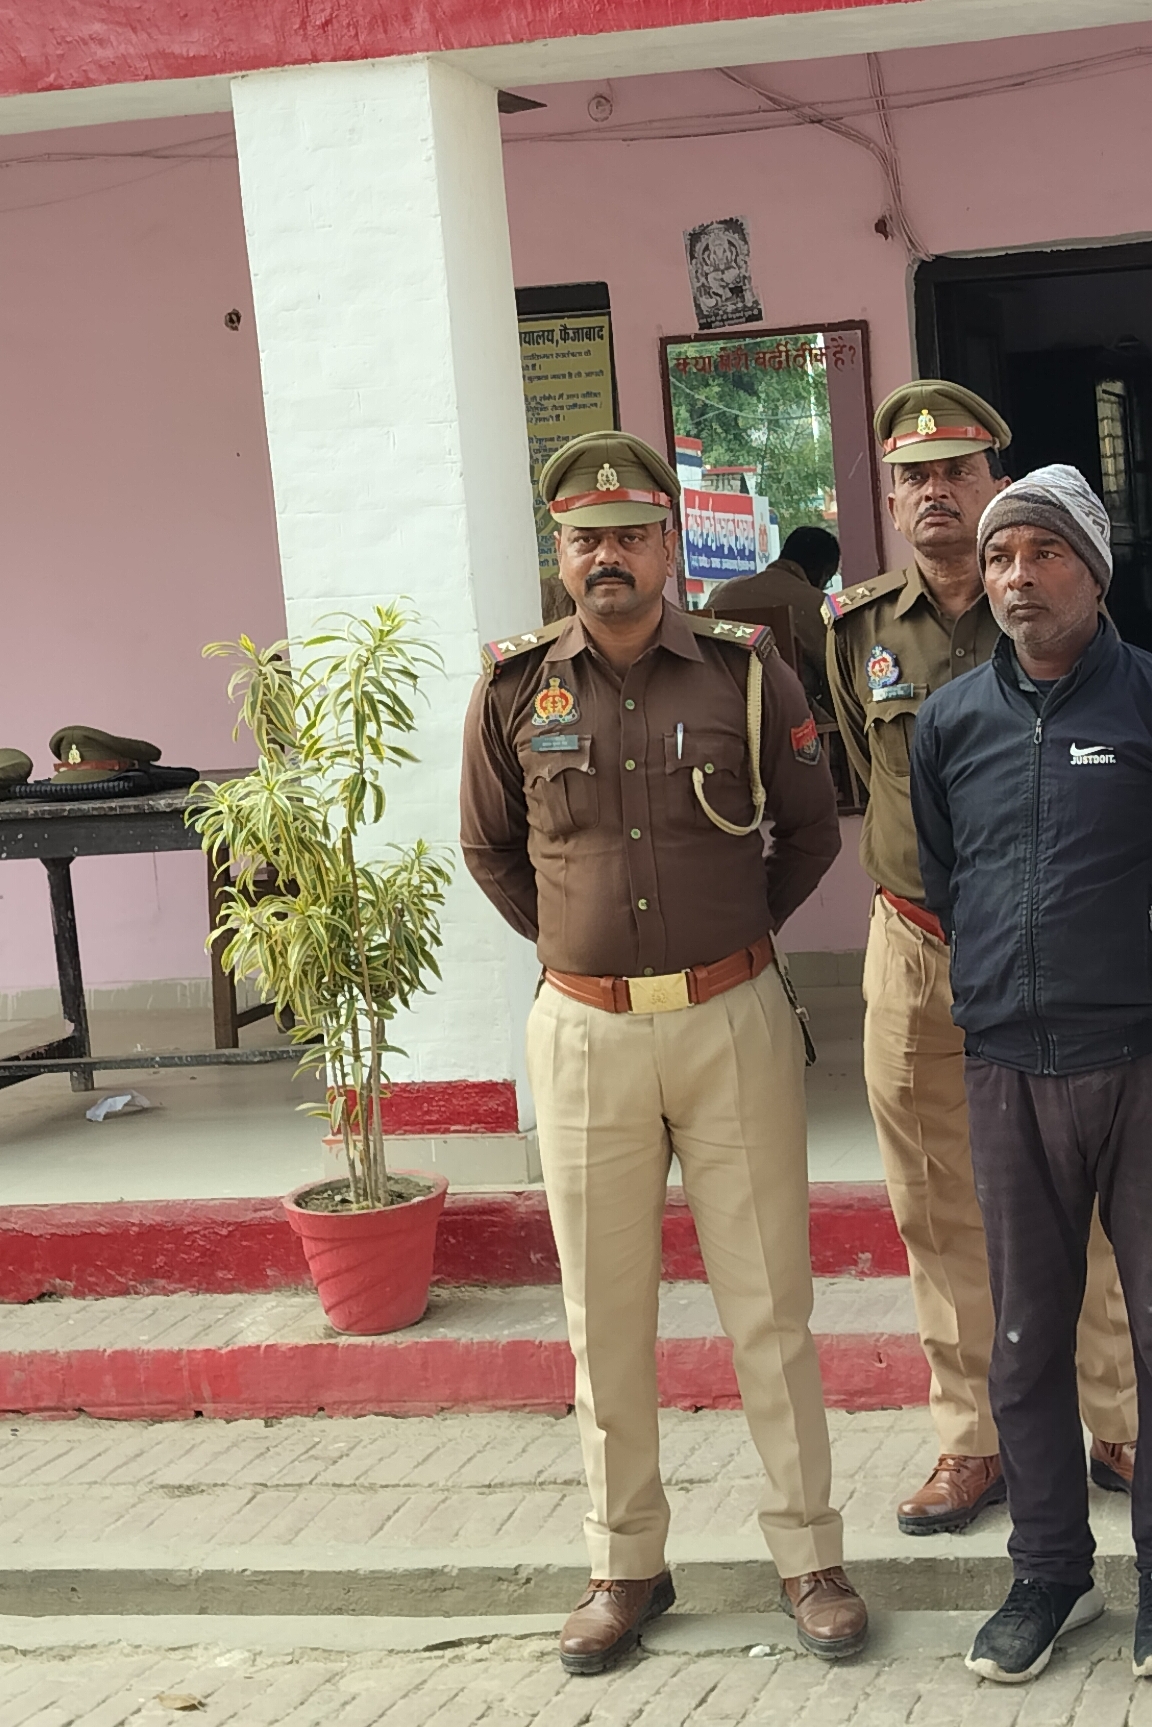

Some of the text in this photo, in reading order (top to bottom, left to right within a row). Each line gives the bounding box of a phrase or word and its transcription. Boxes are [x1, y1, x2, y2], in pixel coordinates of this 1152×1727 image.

[674, 355, 713, 376] क्या
[755, 341, 791, 371] वर्दी
[793, 341, 828, 370] ठीक
